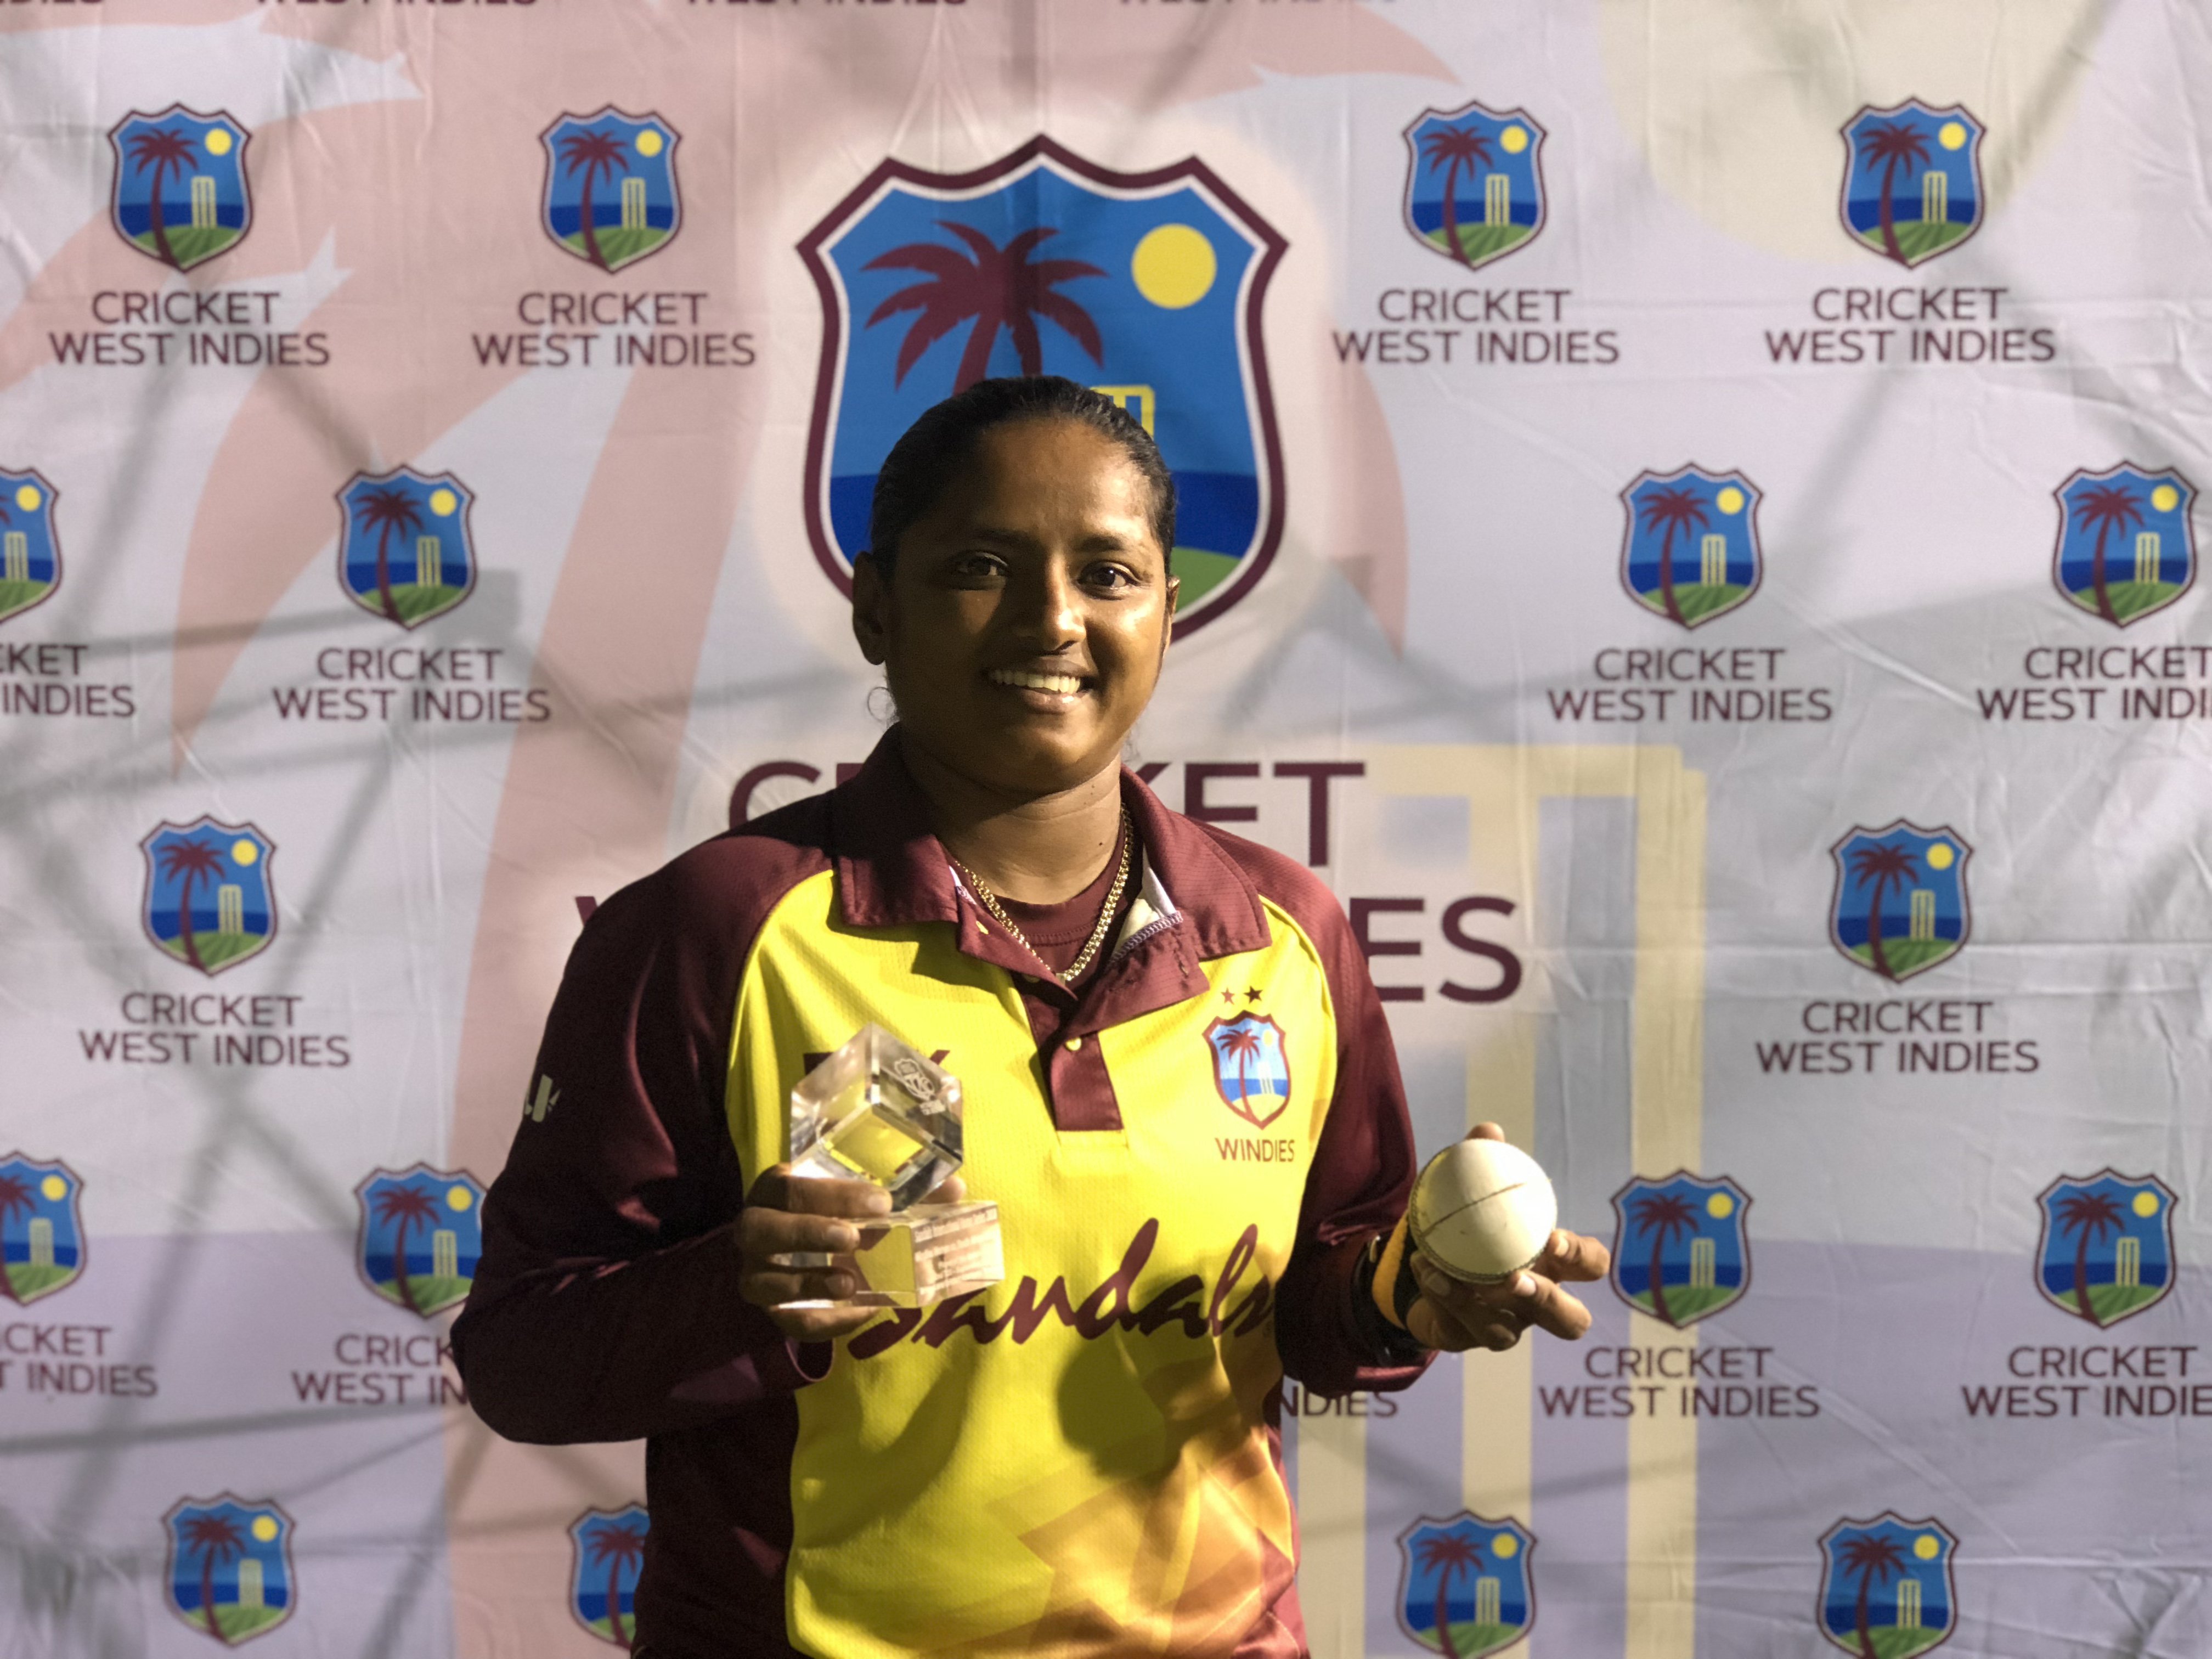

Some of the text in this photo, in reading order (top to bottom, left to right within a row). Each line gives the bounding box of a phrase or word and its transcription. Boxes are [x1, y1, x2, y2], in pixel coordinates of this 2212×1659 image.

[92, 291, 280, 325] CRICKET
[518, 292, 707, 326] CRICKET
[1378, 289, 1571, 323] CRICKET
[1813, 287, 2007, 321] CRICKET
[49, 332, 330, 366] WEST INDIES
[472, 333, 756, 367] WEST INDIES
[1333, 330, 1620, 364] WEST INDIES
[1765, 329, 2056, 363] WEST INDIES
[317, 647, 502, 681] CRICKET
[1594, 648, 1785, 681] CRICKET
[2024, 645, 2212, 680] CRICKET
[3, 684, 136, 718] INDIES
[273, 688, 551, 722] WEST INDIES
[1548, 689, 1833, 722] WEST INDIES
[1977, 687, 2212, 721] WEST INDI
[121, 992, 302, 1027] CRICKET
[1802, 1000, 1993, 1034] CRICKET
[79, 1031, 351, 1068] WEST INDIES
[1756, 1041, 2040, 1074] WEST INDIES
[1215, 1137, 1295, 1163] WINDIES
[335, 1334, 453, 1367] CRICK
[1584, 1346, 1773, 1379] CRICKET
[2008, 1346, 2197, 1378] CRICKET
[28, 1363, 158, 1397] INDIES
[292, 1372, 413, 1404] WEST
[1280, 1385, 1398, 1417] NDIES
[1539, 1385, 1820, 1418] WEST INDIES
[1962, 1385, 2089, 1417] WEST
